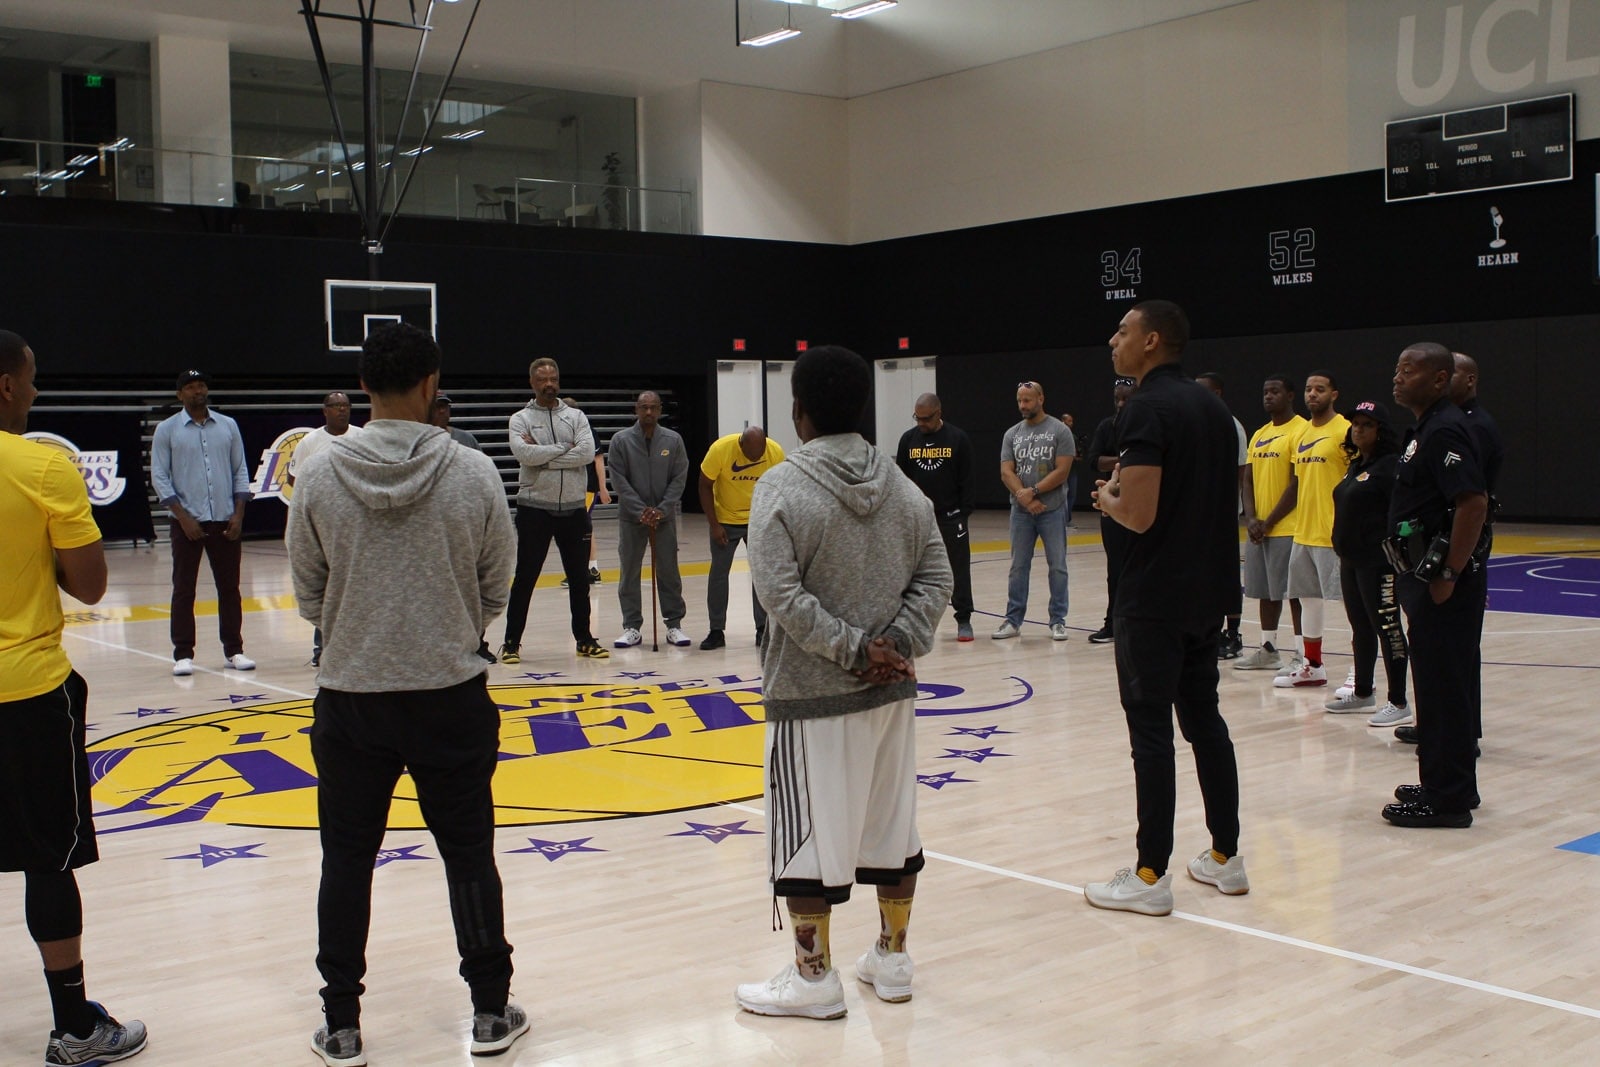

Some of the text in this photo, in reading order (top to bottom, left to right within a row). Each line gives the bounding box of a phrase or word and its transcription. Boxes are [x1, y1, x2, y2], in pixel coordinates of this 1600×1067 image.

[1458, 143, 1478, 152] PERIOD
[1545, 144, 1564, 154] FOULS
[1457, 154, 1493, 166] PLAYER FOUL
[1392, 166, 1409, 175] FOULS
[1269, 227, 1316, 271] 52
[1478, 252, 1519, 267] HEARN
[1101, 247, 1142, 287] 34
[1273, 272, 1313, 286] WILKES
[1106, 288, 1137, 301] O'NEAL
[909, 447, 952, 459] LOS ANGELES
[1013, 442, 1055, 462] Lakers
[1253, 451, 1280, 459] LAKERS
[68, 454, 112, 464] GELES
[1297, 456, 1327, 465] LAKERS
[1381, 574, 1395, 606] PINK
[810, 961, 826, 976] 24
